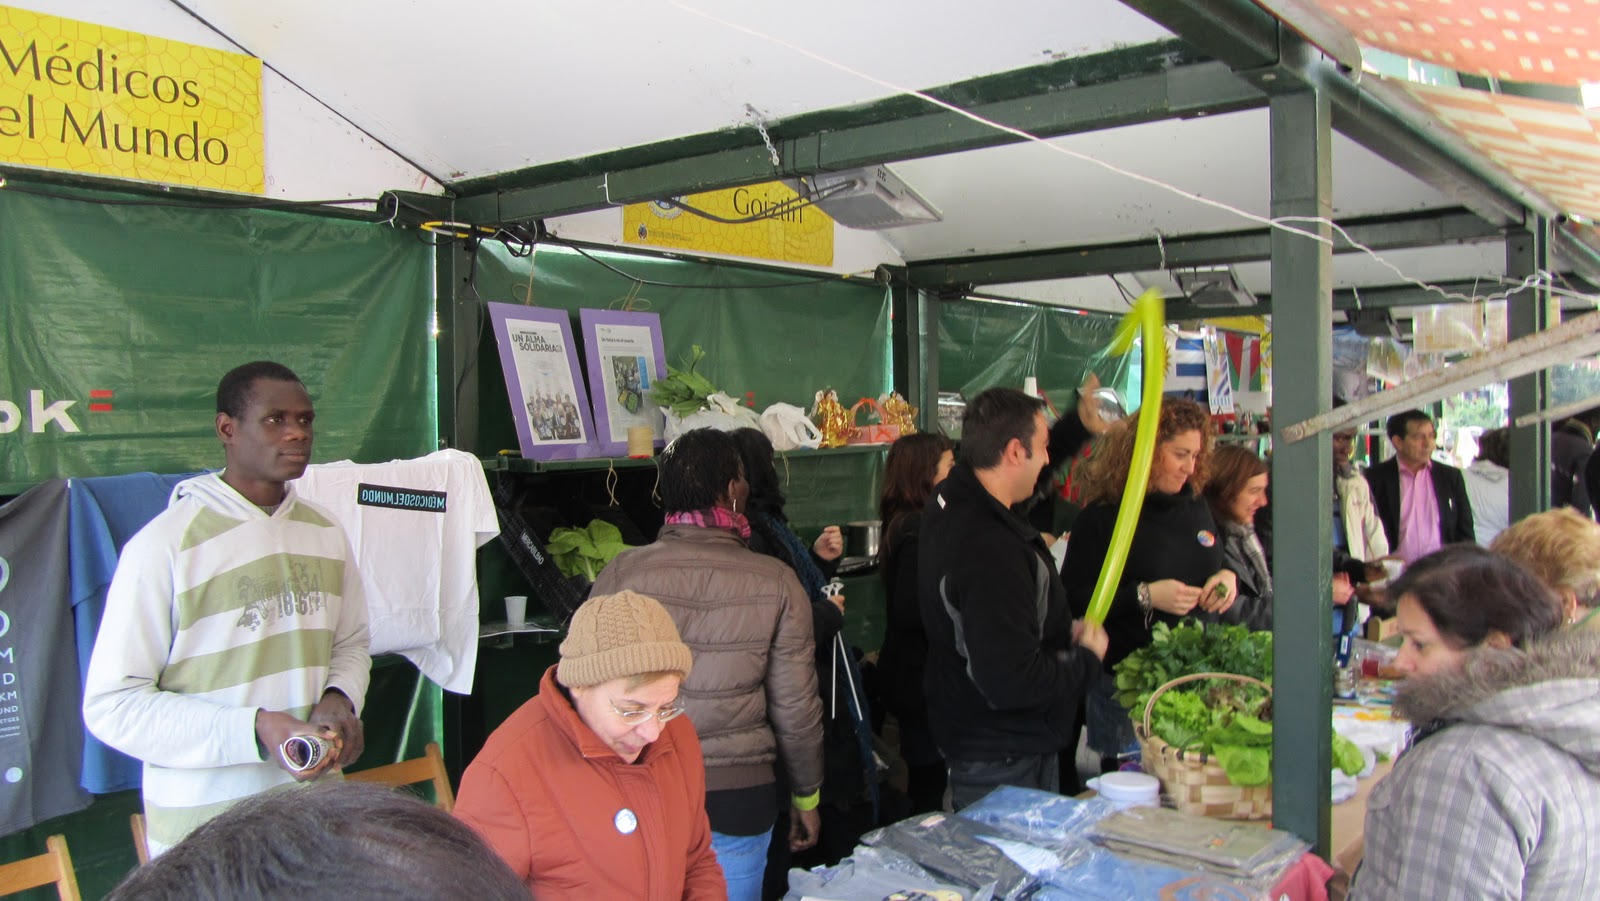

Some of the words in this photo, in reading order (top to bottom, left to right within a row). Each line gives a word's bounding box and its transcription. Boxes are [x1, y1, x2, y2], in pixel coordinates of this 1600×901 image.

[0, 38, 200, 108] Médicos
[61, 103, 229, 166] Mundo
[511, 333, 524, 342] UN
[525, 335, 546, 344] ALMA
[519, 343, 557, 352] SOLIDARIA
